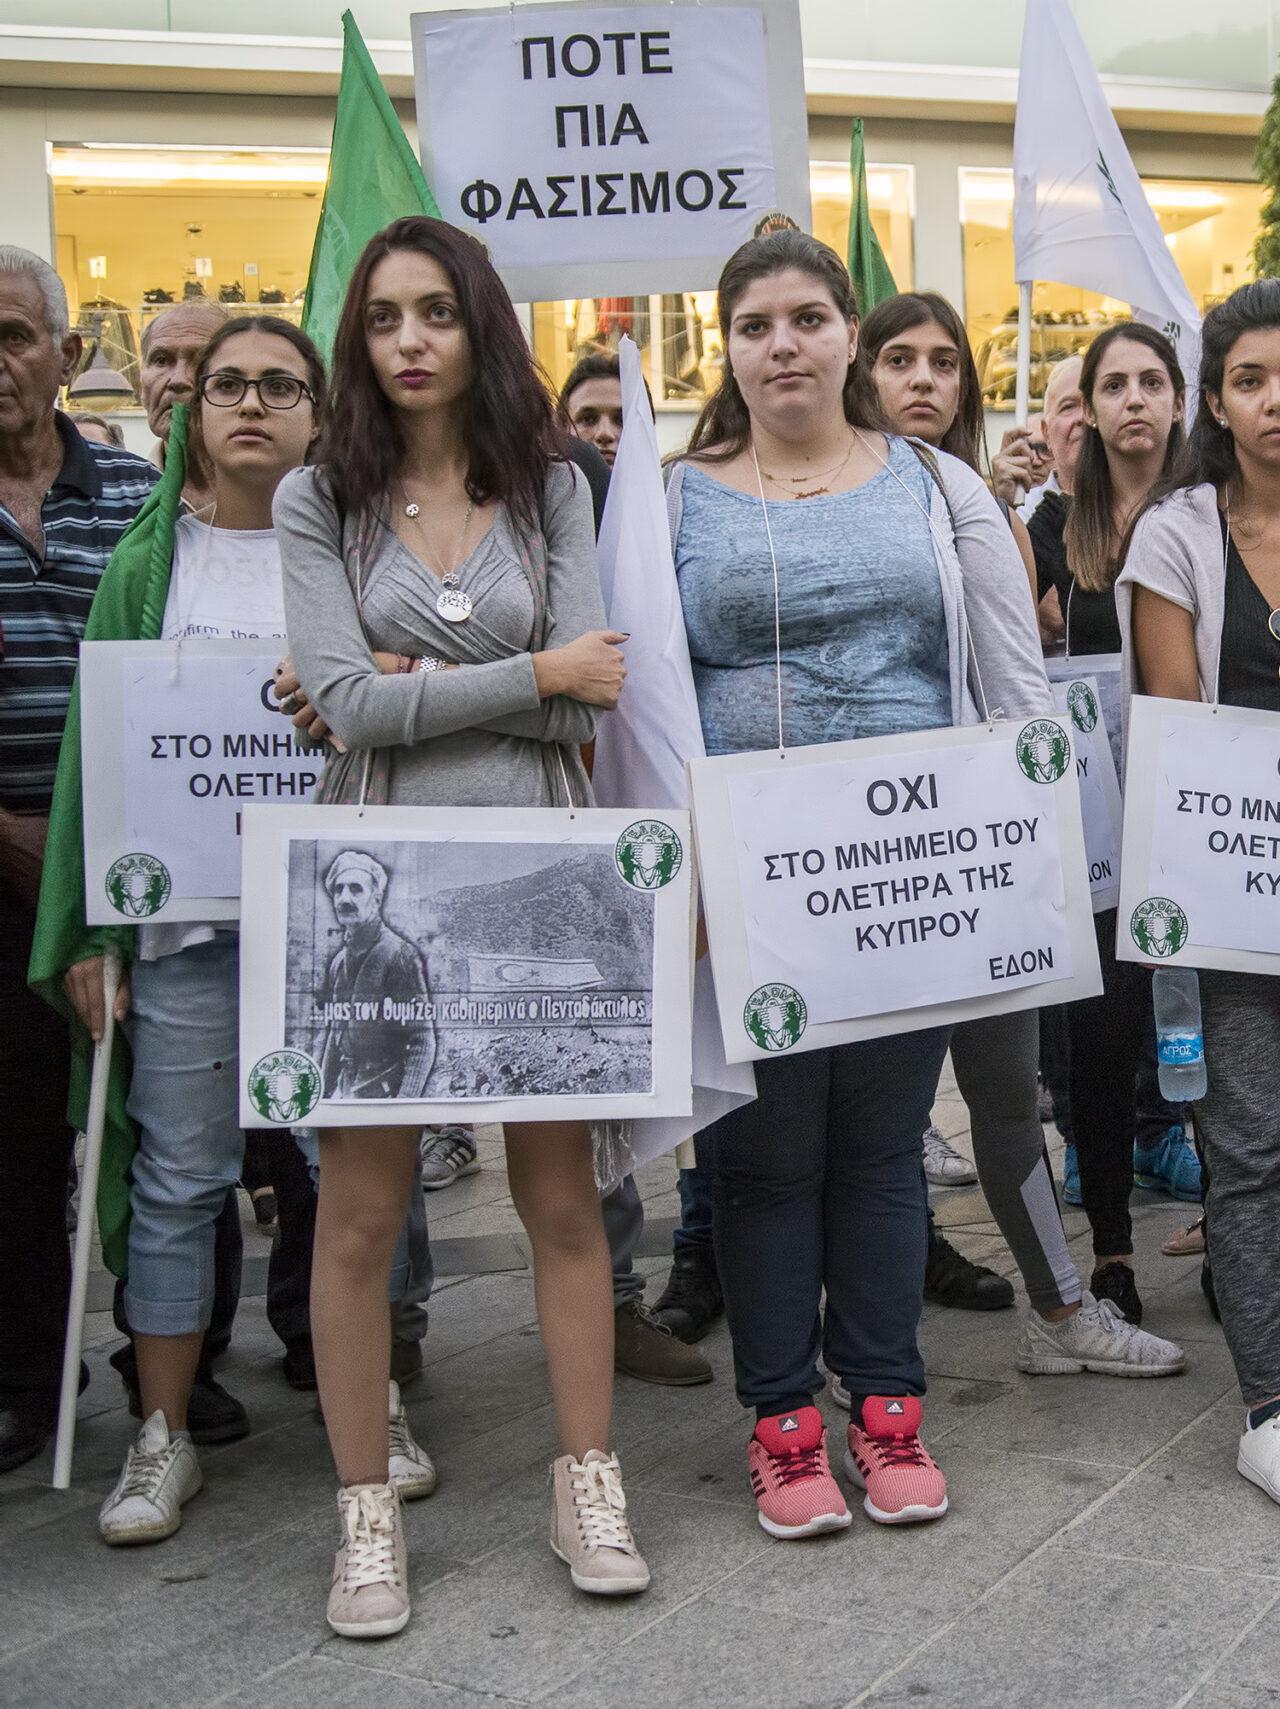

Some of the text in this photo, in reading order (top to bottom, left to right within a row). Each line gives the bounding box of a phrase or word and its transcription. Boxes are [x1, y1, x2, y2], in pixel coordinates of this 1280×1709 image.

[521, 31, 673, 80] ΠΟΤΕ
[555, 103, 650, 148] ΠΙΑ
[460, 168, 747, 223] ΦΑΣΙΣΜΟΣ
[151, 734, 212, 759] ΣΤΟ
[189, 772, 317, 798] ΟΛΕΤΗΡ
[866, 773, 939, 816] ΟΧΙ
[1177, 790, 1232, 816] ΣΤΟ
[764, 817, 1039, 881] ΣΤΟ ΜΝΗΜΕΙΟ ΤΟΥ
[806, 862, 1014, 916] ΟΛΕΤΗΡΑ ΤΗΣ
[855, 908, 980, 951] ΚΥΠΡΟΥ
[989, 946, 1054, 980] ΕΔΟΝ
[354, 1001, 379, 1021] τον
[383, 997, 437, 1026] θυμίζει
[442, 997, 525, 1025] καθημερινά
[528, 1001, 539, 1020] ο
[541, 995, 646, 1021] Πενταδάκτυλος
[1163, 1045, 1192, 1056] ΑΓΡΟΣ
